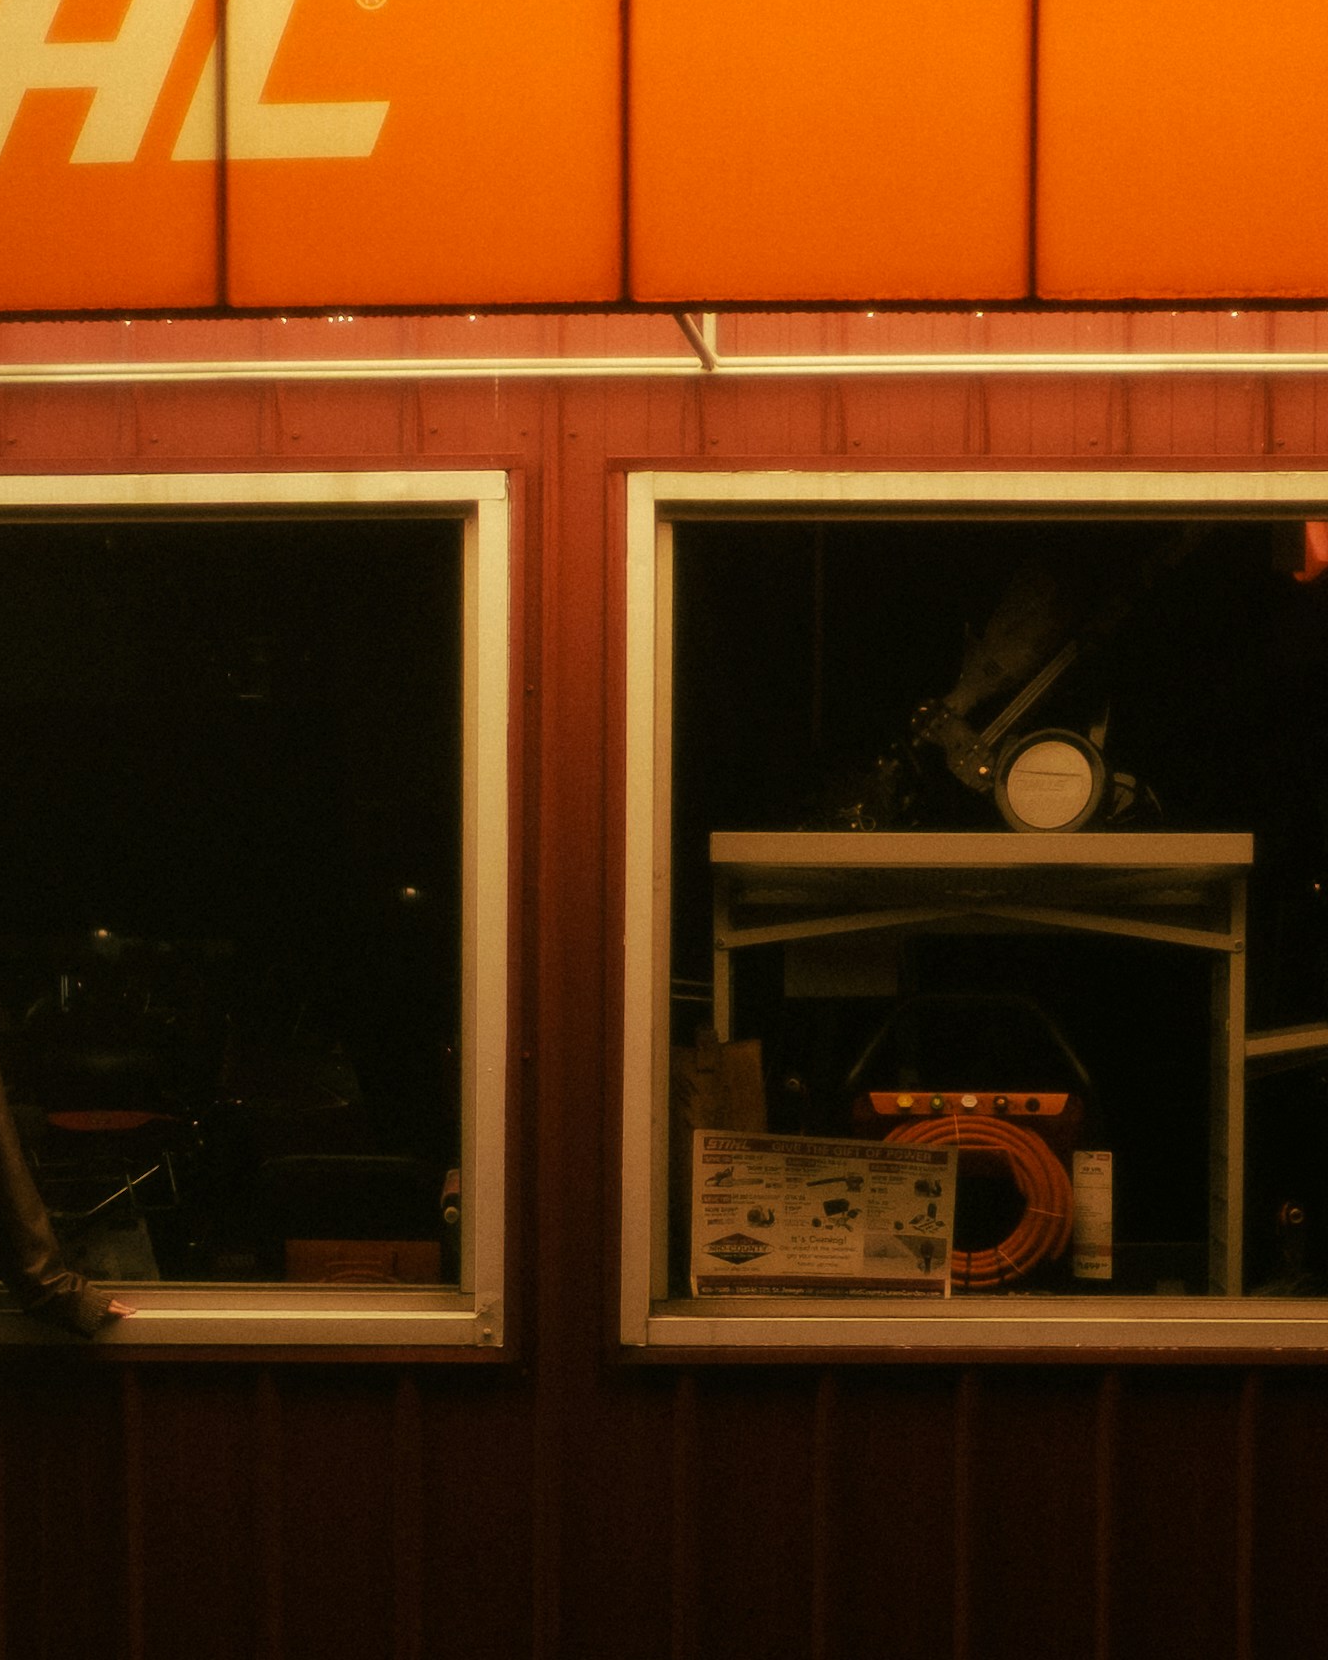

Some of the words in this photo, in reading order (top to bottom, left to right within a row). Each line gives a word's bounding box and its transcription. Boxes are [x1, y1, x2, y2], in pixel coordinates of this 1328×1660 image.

[706, 1138, 751, 1151] STIHL
[772, 1141, 801, 1152] GIVE
[807, 1144, 830, 1154] THE
[833, 1146, 860, 1157] GIFT
[866, 1148, 883, 1158] OF
[886, 1149, 932, 1162] POWER
